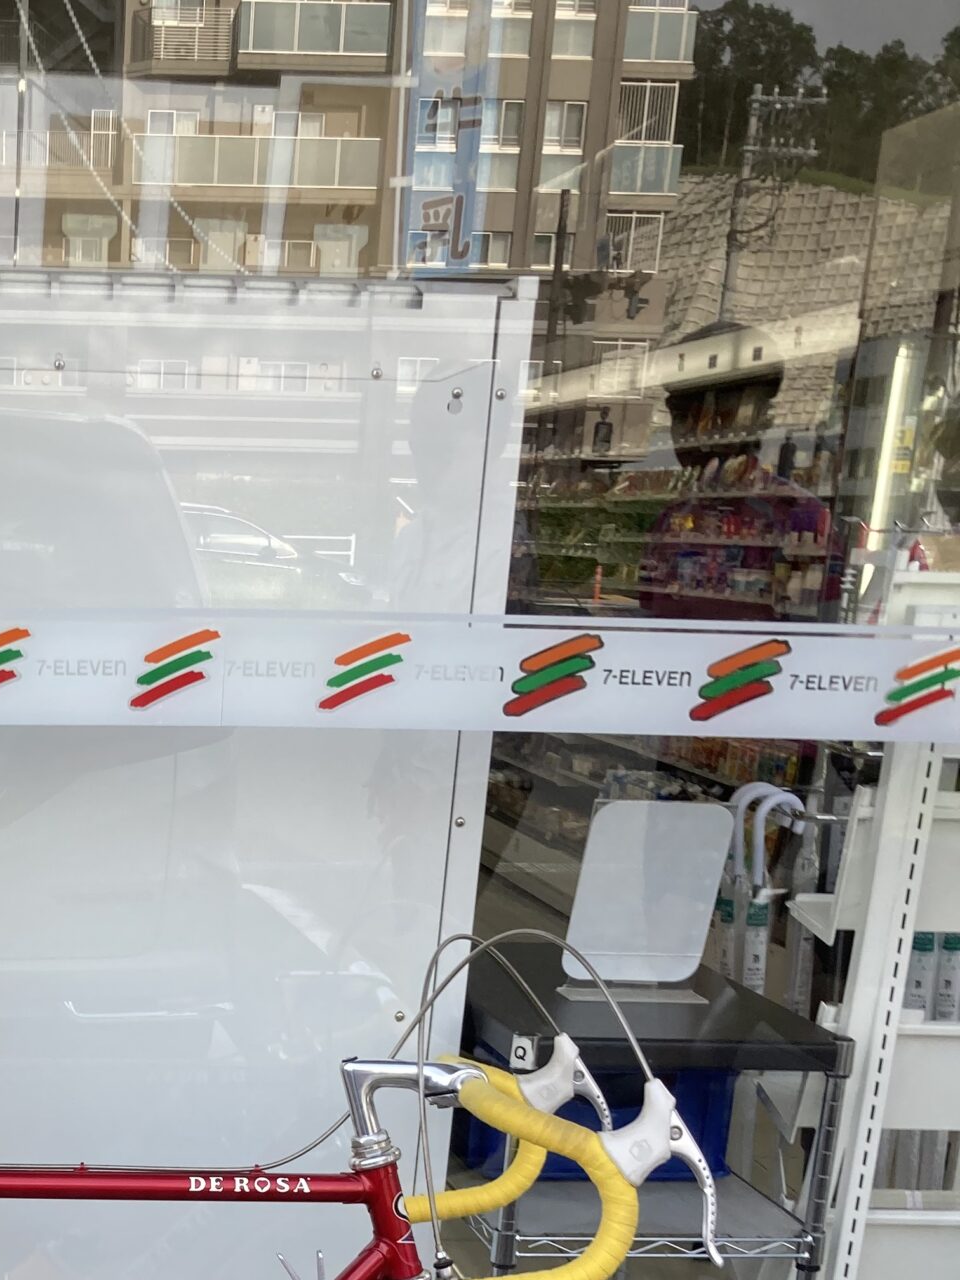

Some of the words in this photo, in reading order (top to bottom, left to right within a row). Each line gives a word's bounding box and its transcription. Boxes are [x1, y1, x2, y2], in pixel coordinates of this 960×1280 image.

[514, 1045, 527, 1061] Q
[189, 1176, 224, 1192] DE
[233, 1176, 311, 1193] ROSA
